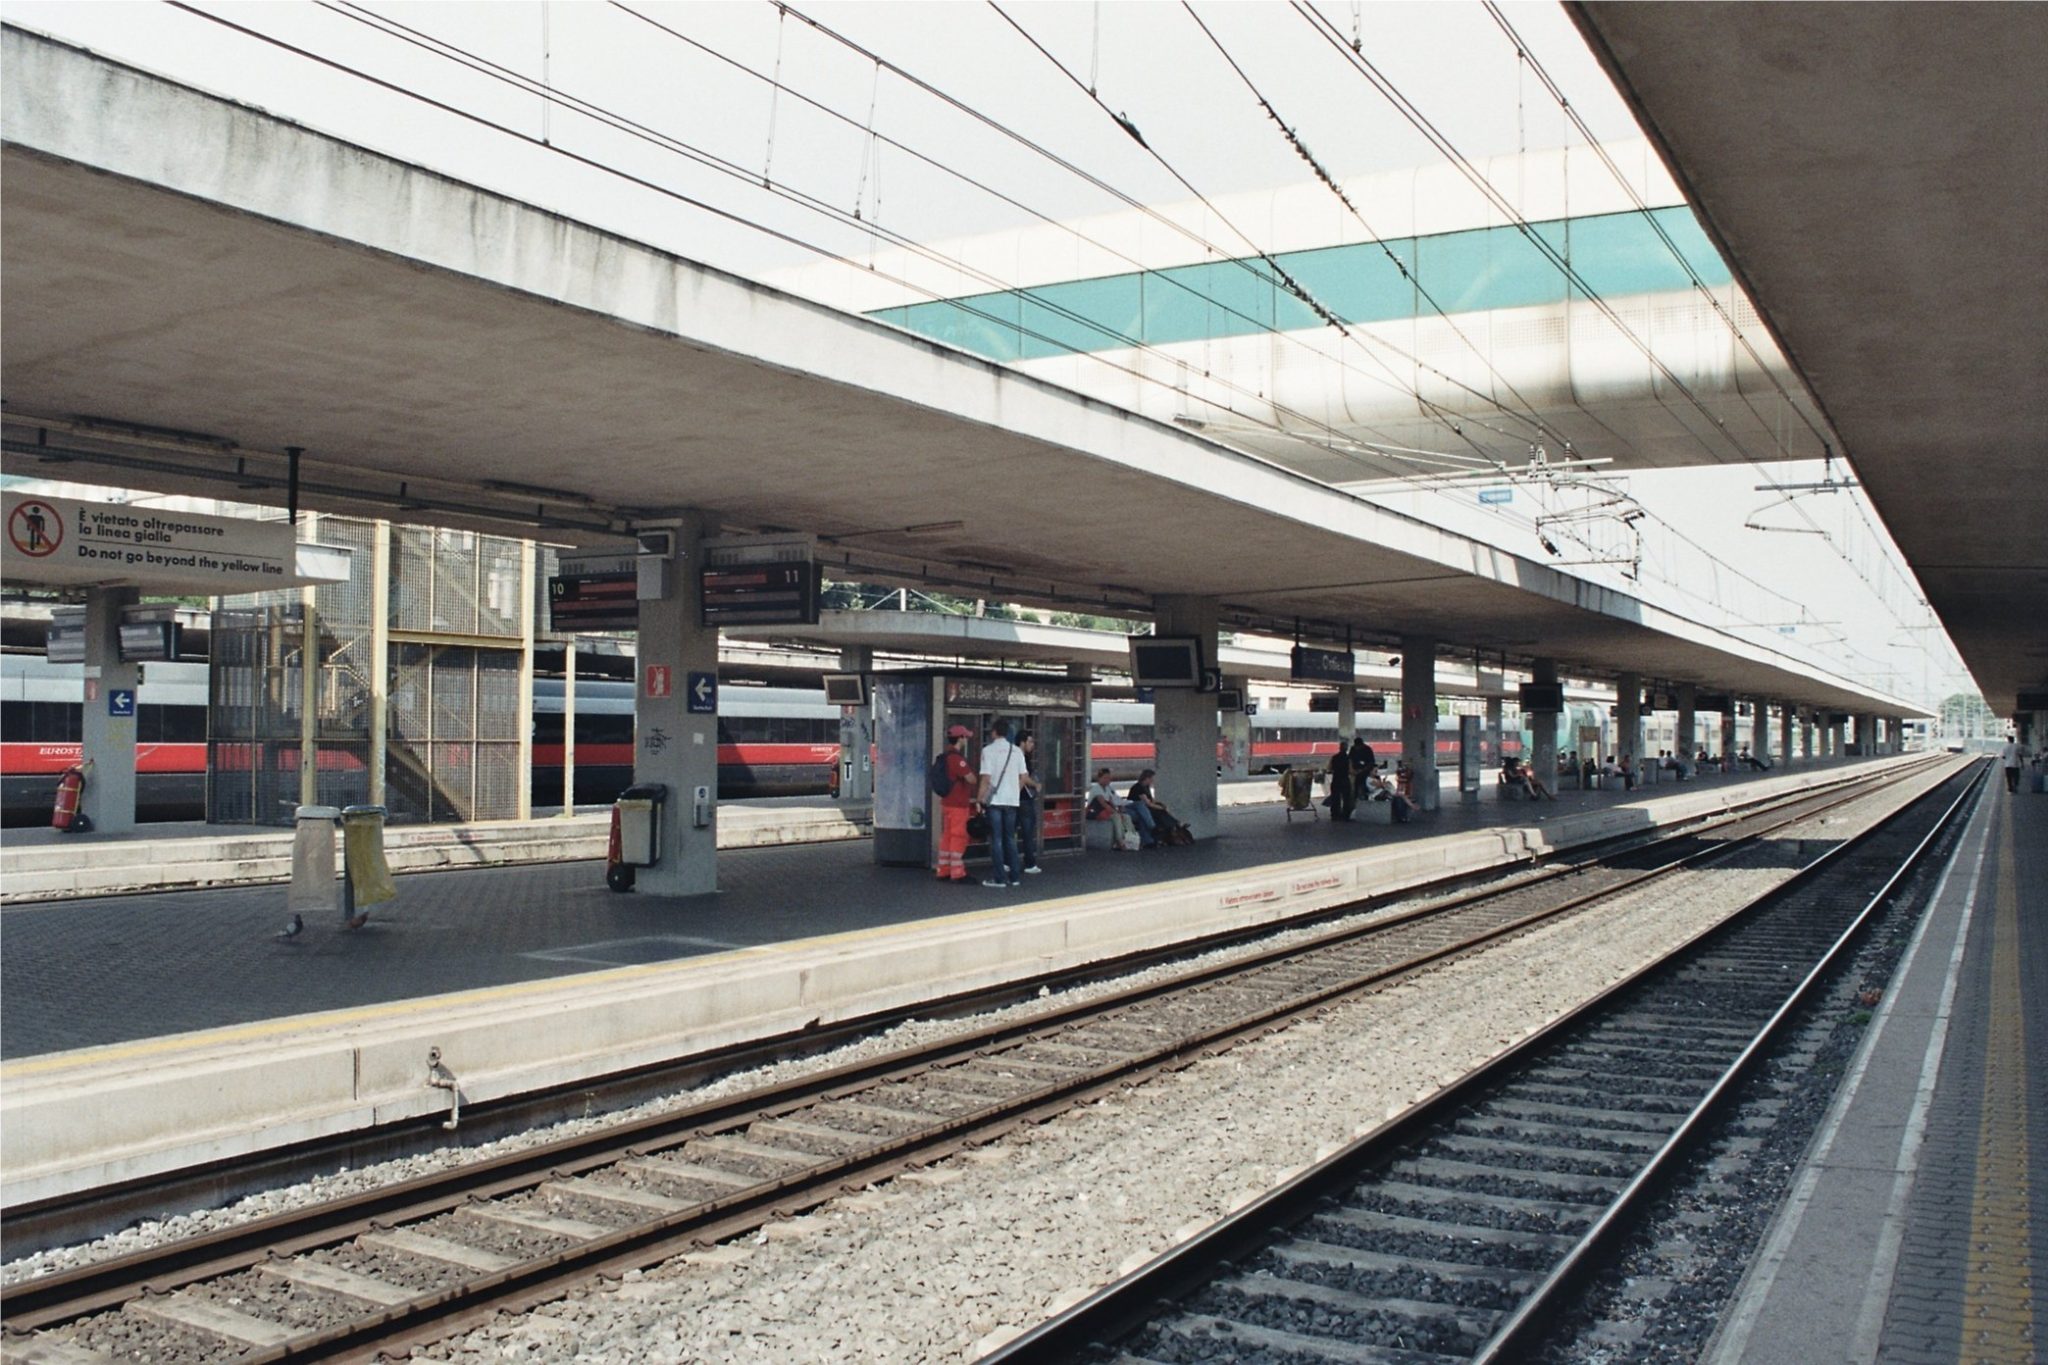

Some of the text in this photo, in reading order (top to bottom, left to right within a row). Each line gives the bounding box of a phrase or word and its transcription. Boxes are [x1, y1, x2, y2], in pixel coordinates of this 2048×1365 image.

[78, 522, 172, 543] la linea gialla
[79, 507, 225, 537] È vietato oltrepassare
[78, 545, 284, 575] Do not go beyond the yellow line
[785, 570, 799, 583] 11
[552, 583, 565, 595] 10
